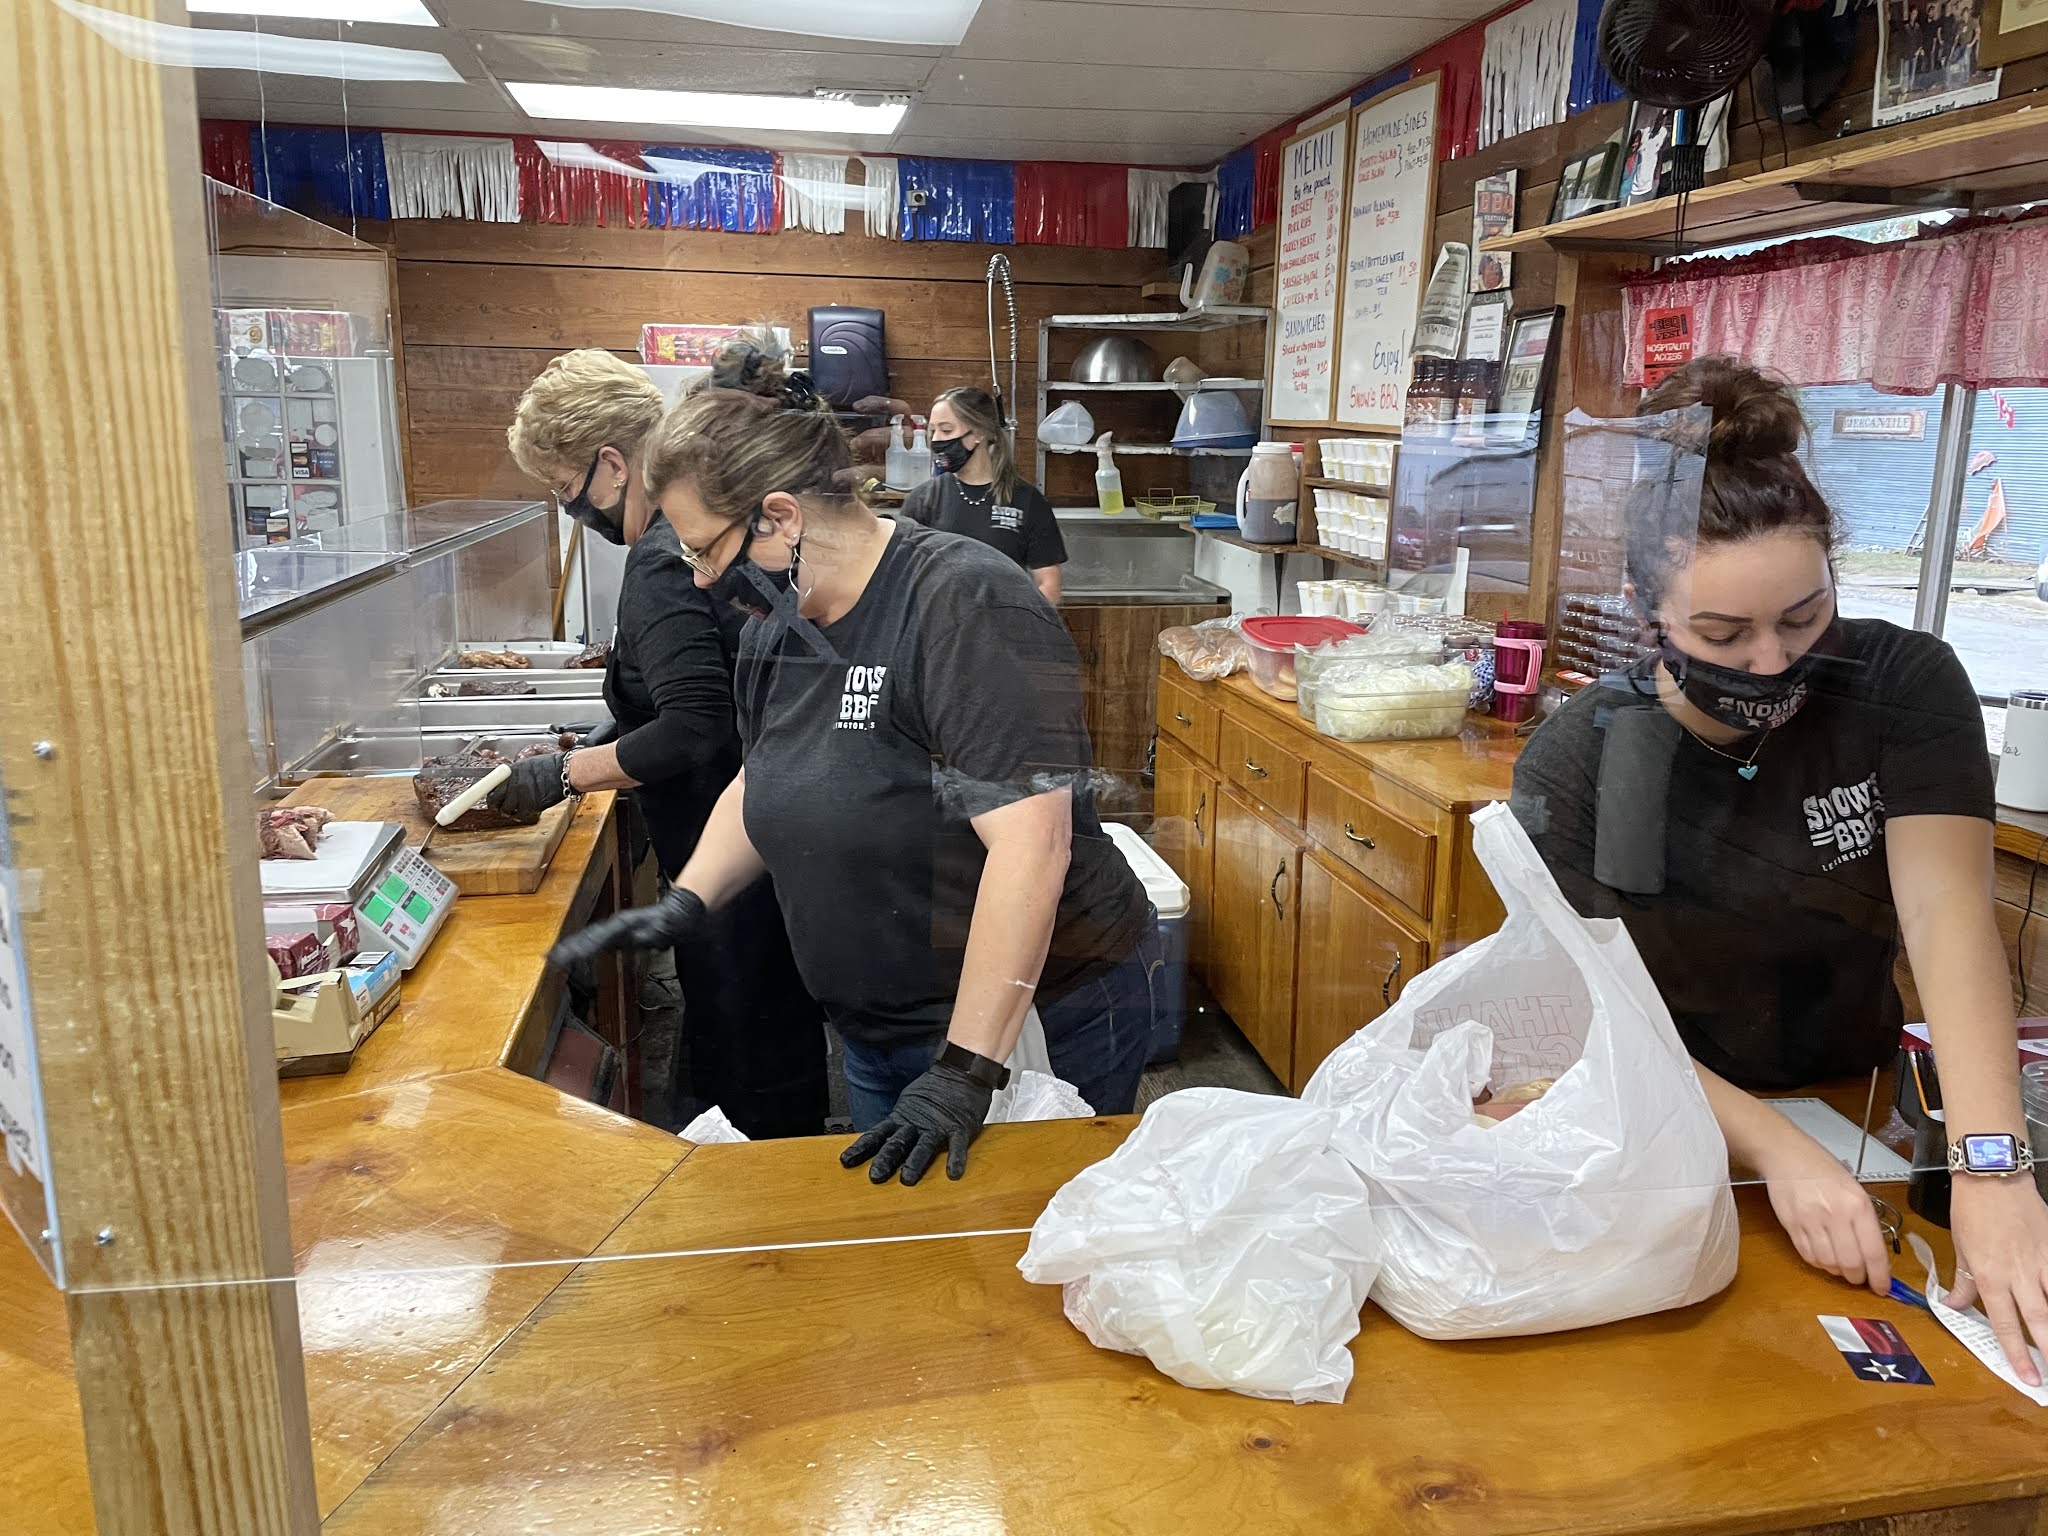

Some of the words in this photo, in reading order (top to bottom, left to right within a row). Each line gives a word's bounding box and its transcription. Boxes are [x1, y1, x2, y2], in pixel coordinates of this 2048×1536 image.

[1935, 101, 1956, 114] Band
[1404, 111, 1427, 135] SIDES
[1294, 131, 1334, 179] MENU
[1303, 181, 1313, 194] the
[1313, 171, 1331, 195] pound
[1291, 198, 1314, 218] BRISKET
[1285, 314, 1326, 338] SANDWICHES
[1655, 315, 1681, 331] BBQ
[1656, 330, 1681, 340] FEST
[1373, 328, 1406, 376] Enjoy!
[1646, 342, 1691, 353] HOSPITALITY
[1653, 352, 1683, 362] ACCESS
[1379, 383, 1399, 411] BBQ
[1844, 416, 1910, 429] MERCANTILE
